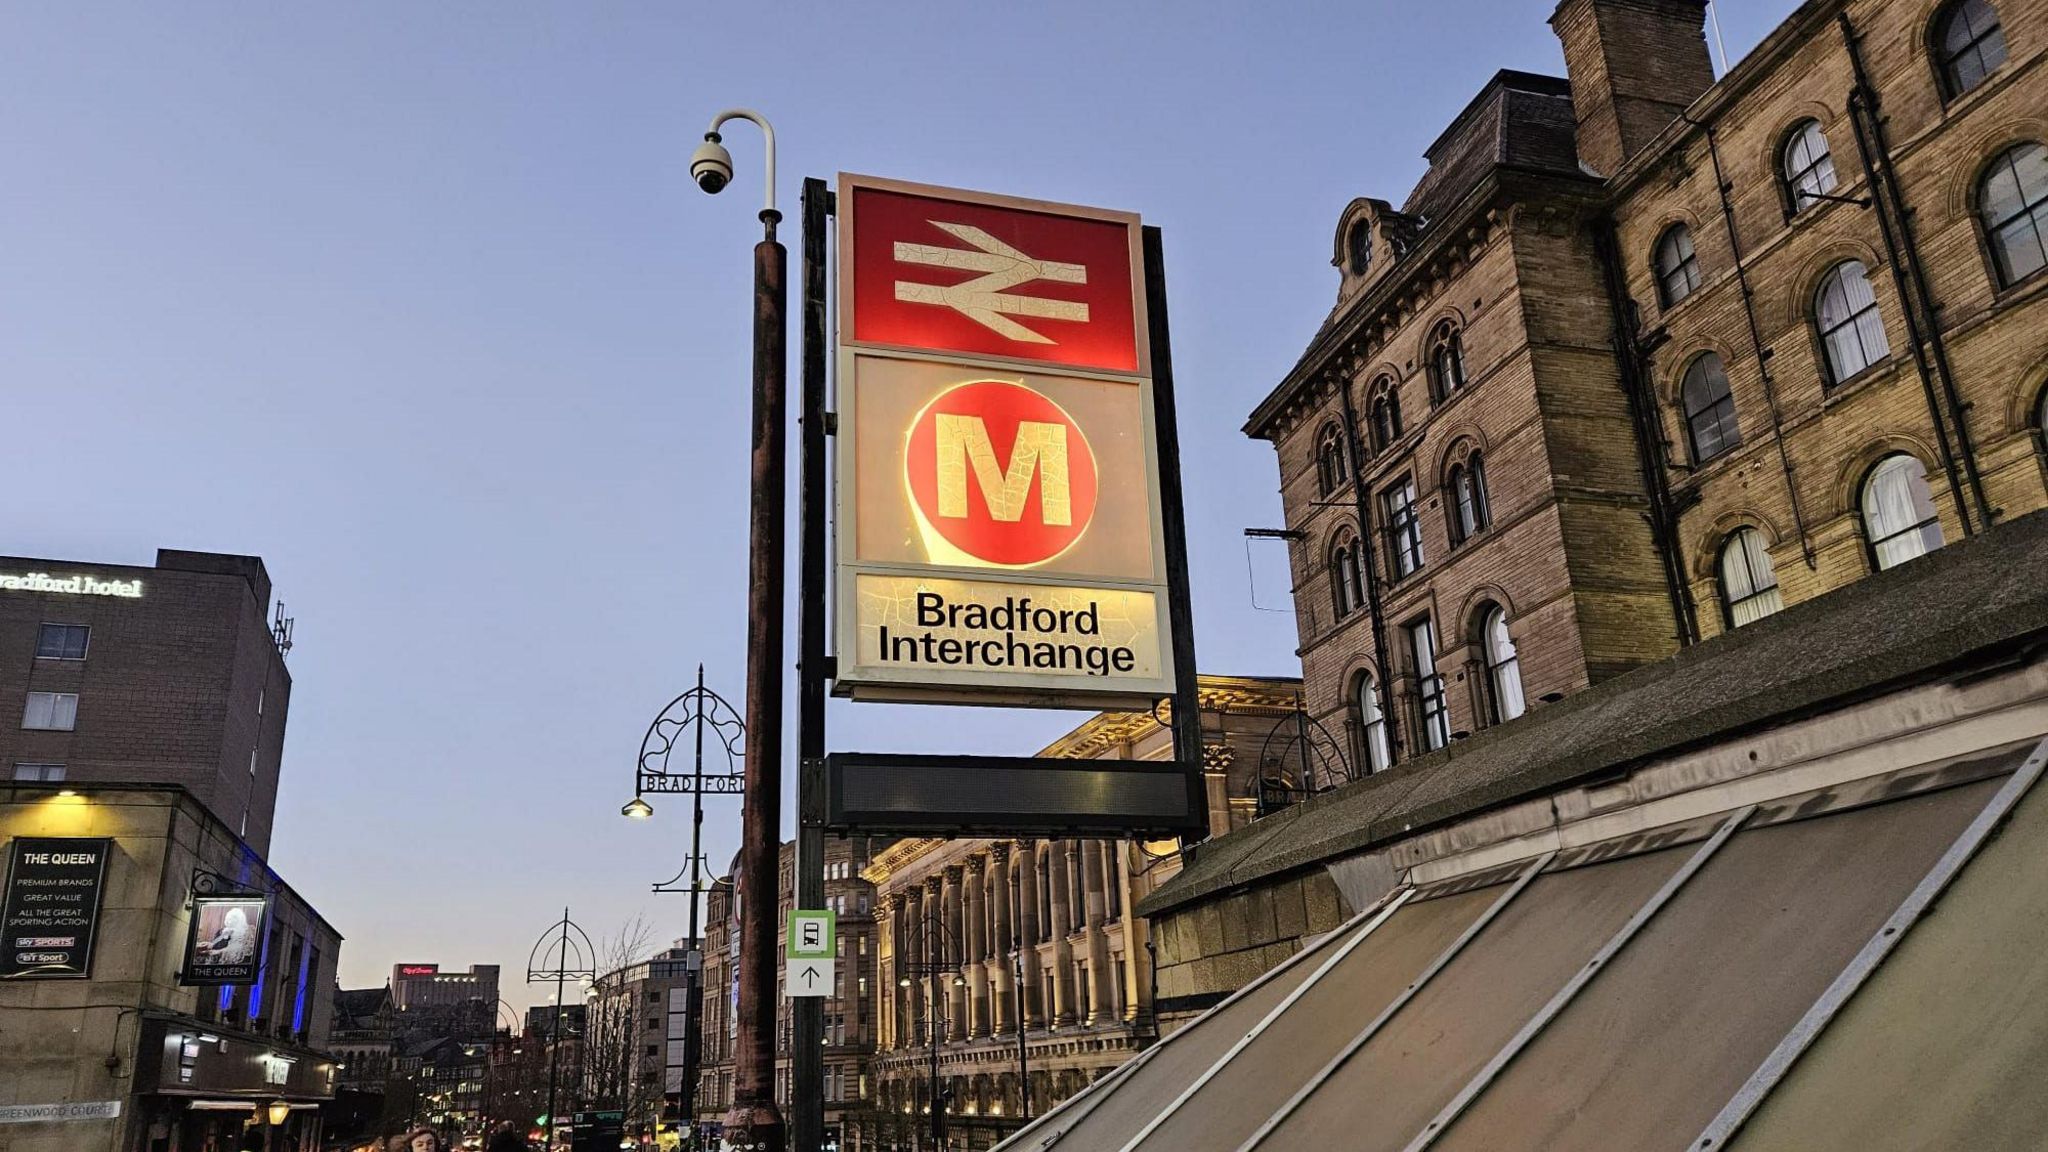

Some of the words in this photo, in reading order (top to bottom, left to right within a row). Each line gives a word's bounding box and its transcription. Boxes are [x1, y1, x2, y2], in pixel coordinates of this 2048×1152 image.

[935, 413, 1072, 526] M
[82, 576, 142, 597] hotel
[916, 592, 1099, 635] Bradford
[879, 626, 1135, 676] Interchange
[23, 853, 49, 865] THE
[51, 853, 96, 865] QUEEN
[16, 879, 57, 887] PREMIUM
[58, 879, 94, 887] BRANDS
[23, 894, 53, 902] GREAT
[54, 894, 82, 902] VALUE
[19, 909, 34, 917] ALL
[36, 908, 51, 917] THE
[52, 908, 83, 917] GREAT
[9, 918, 53, 926] SPORTING
[54, 918, 89, 926] ACTION
[38, 953, 63, 963] Sport
[194, 968, 212, 976] THE
[213, 967, 248, 976] QUEEN
